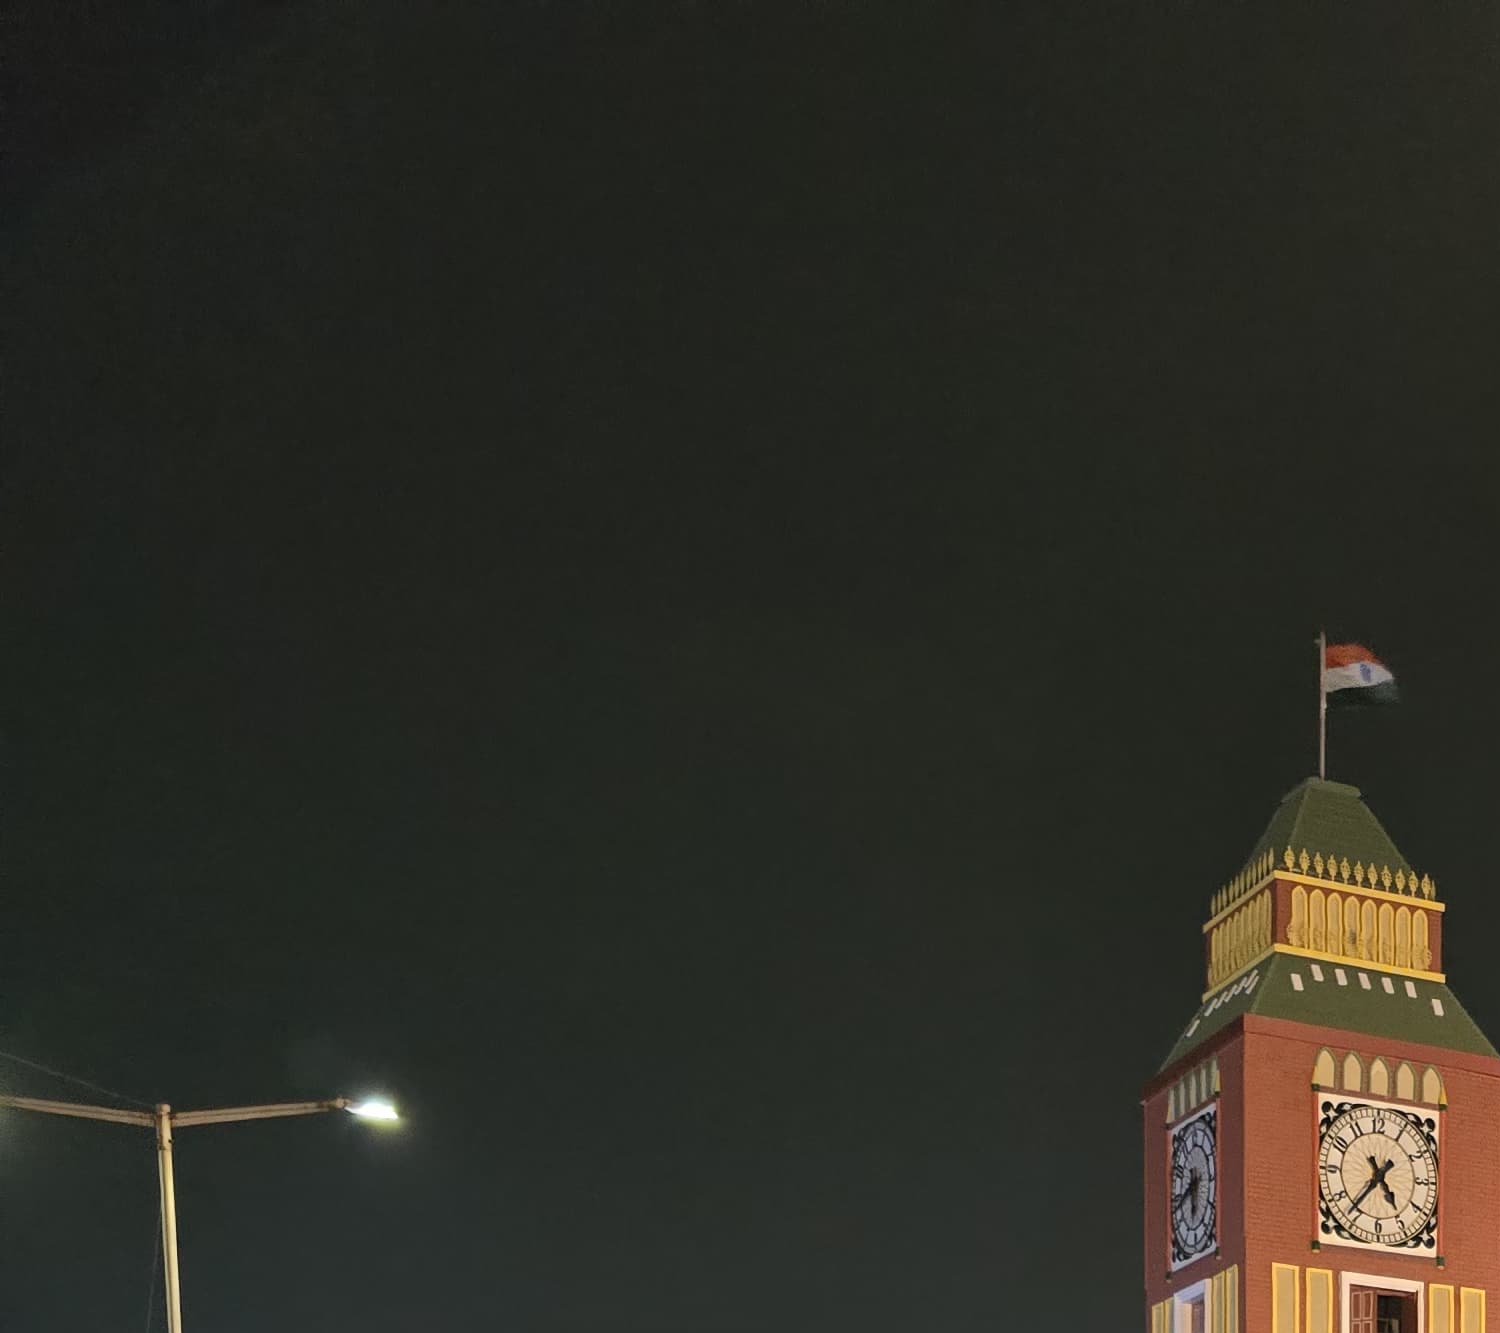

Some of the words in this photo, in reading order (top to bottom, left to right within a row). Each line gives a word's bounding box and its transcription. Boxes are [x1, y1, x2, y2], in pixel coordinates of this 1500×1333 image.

[1373, 1118, 1385, 1134] 12
[1409, 1150, 1423, 1162] 2
[1415, 1177, 1429, 1186] 3
[1334, 1191, 1346, 1201] 8
[1410, 1201, 1422, 1213] 4
[1375, 1220, 1382, 1233] 6
[1395, 1215, 1405, 1230] 5
